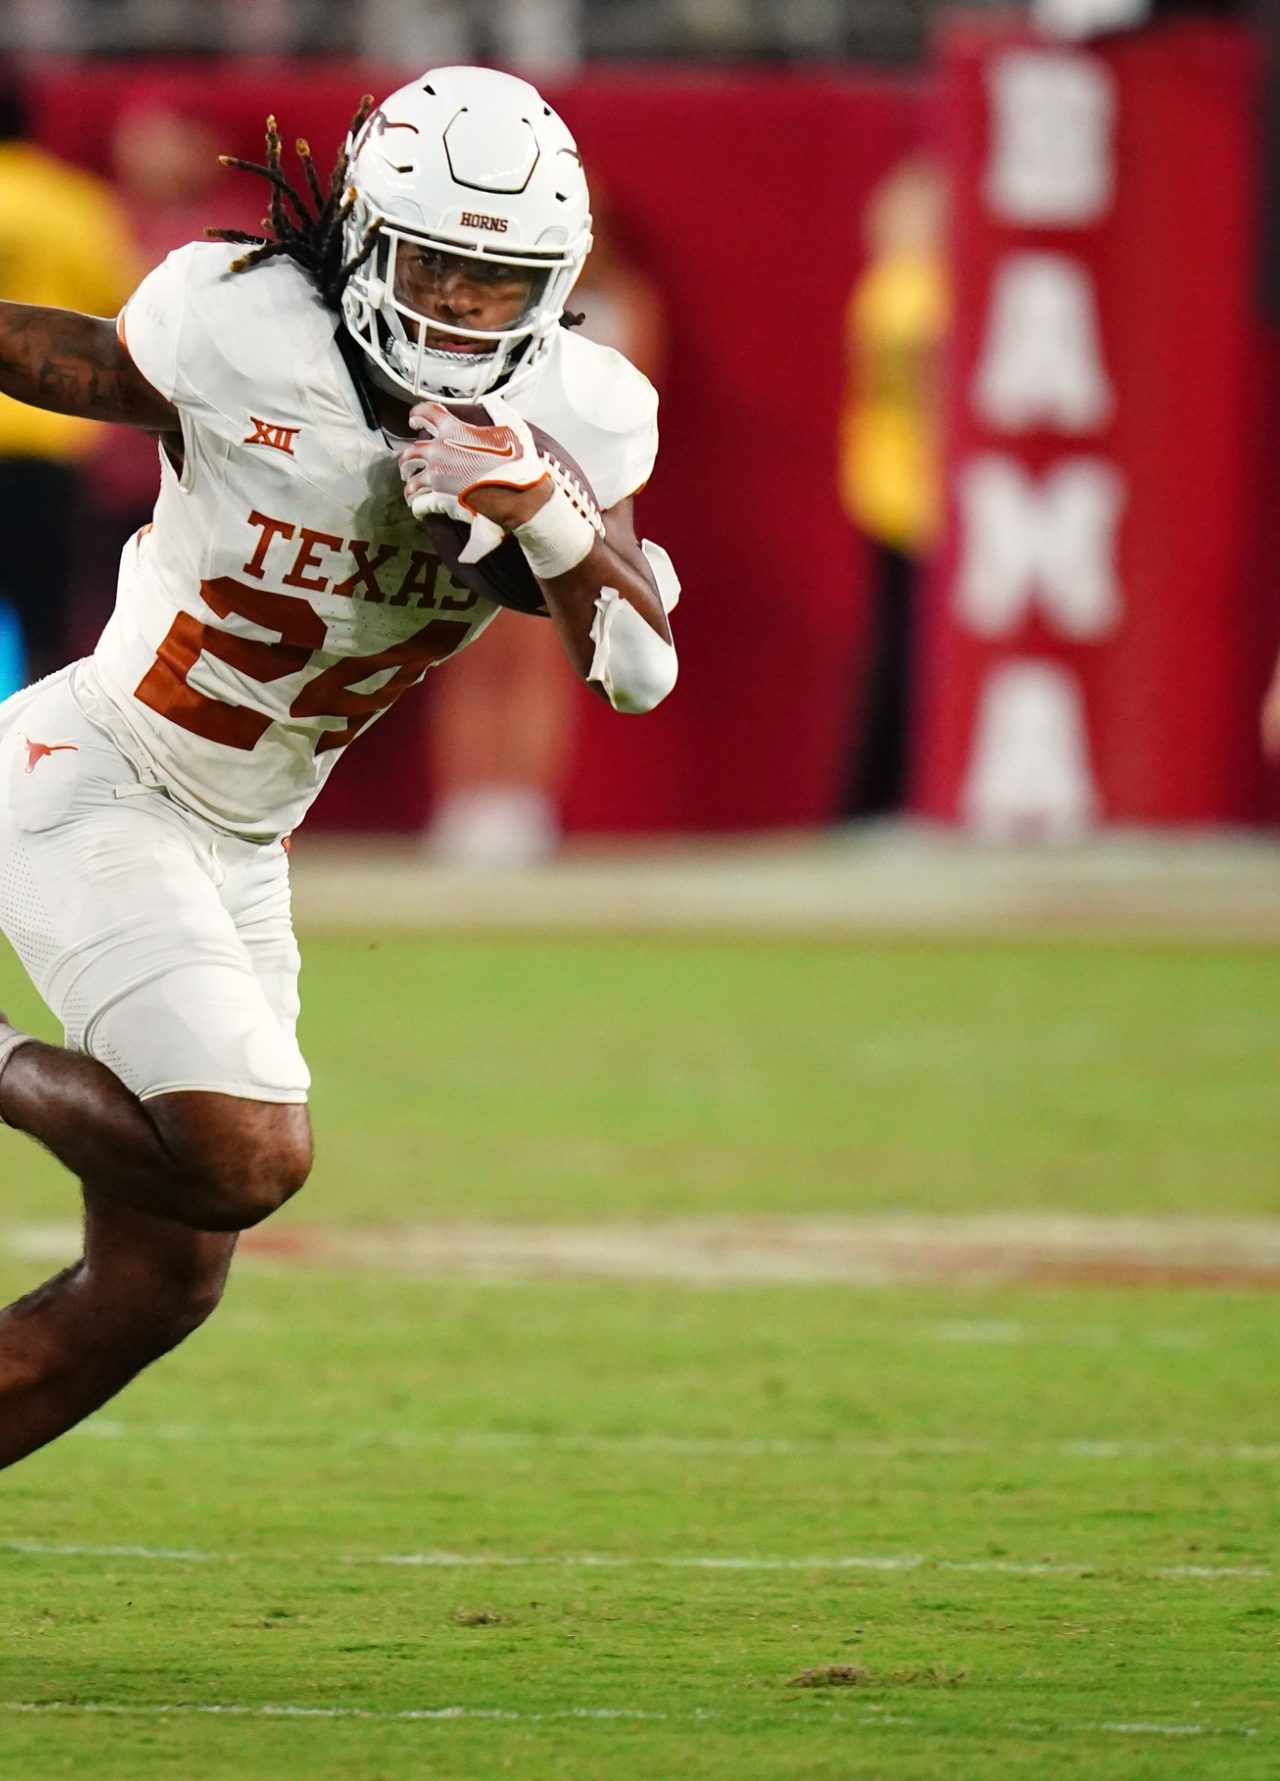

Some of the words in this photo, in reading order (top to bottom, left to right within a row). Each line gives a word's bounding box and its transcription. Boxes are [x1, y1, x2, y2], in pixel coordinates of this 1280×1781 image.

[459, 212, 509, 232] HORNS
[243, 415, 302, 456] XII
[242, 509, 478, 612] TEXAS
[133, 575, 472, 757] 24
